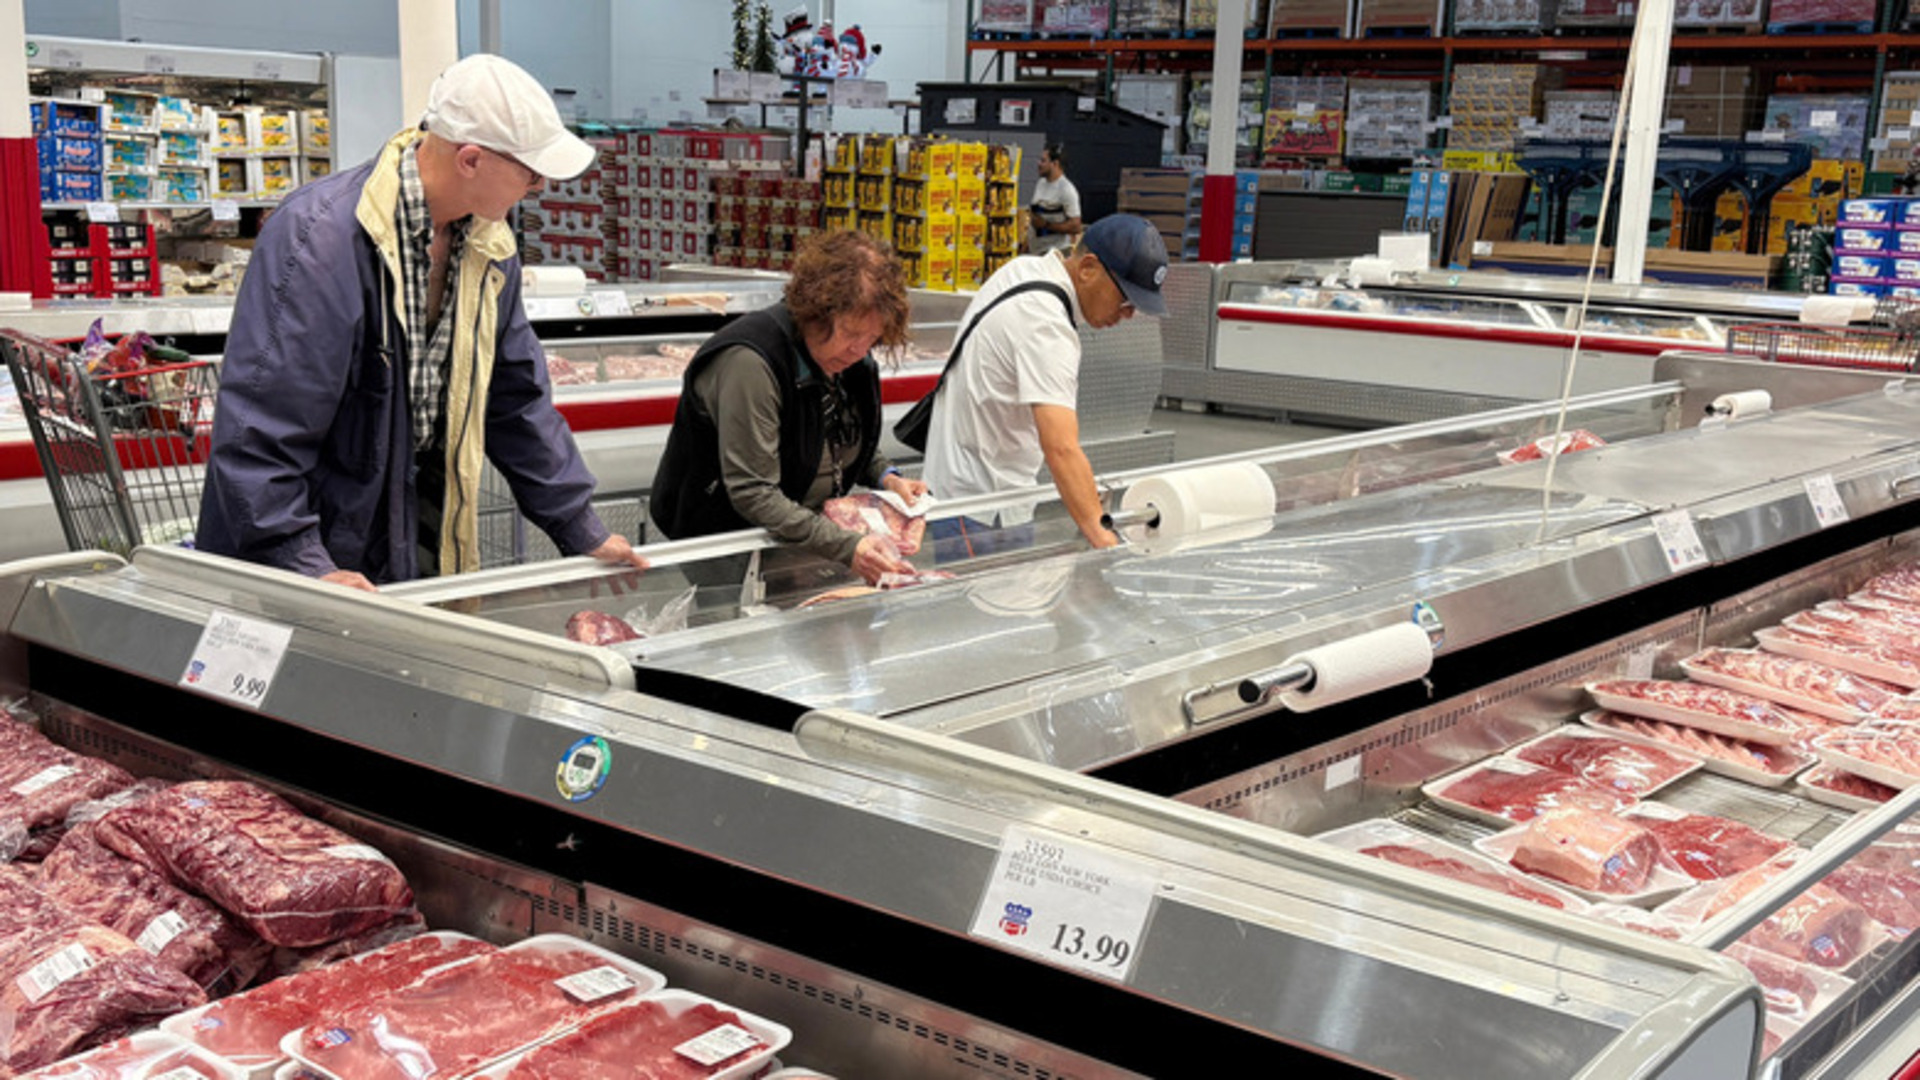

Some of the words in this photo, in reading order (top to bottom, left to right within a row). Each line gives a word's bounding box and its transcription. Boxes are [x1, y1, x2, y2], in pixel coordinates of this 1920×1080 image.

[231, 673, 266, 700] 9.99
[1085, 871, 1110, 886] YORK
[1052, 923, 1130, 968] 13.99
